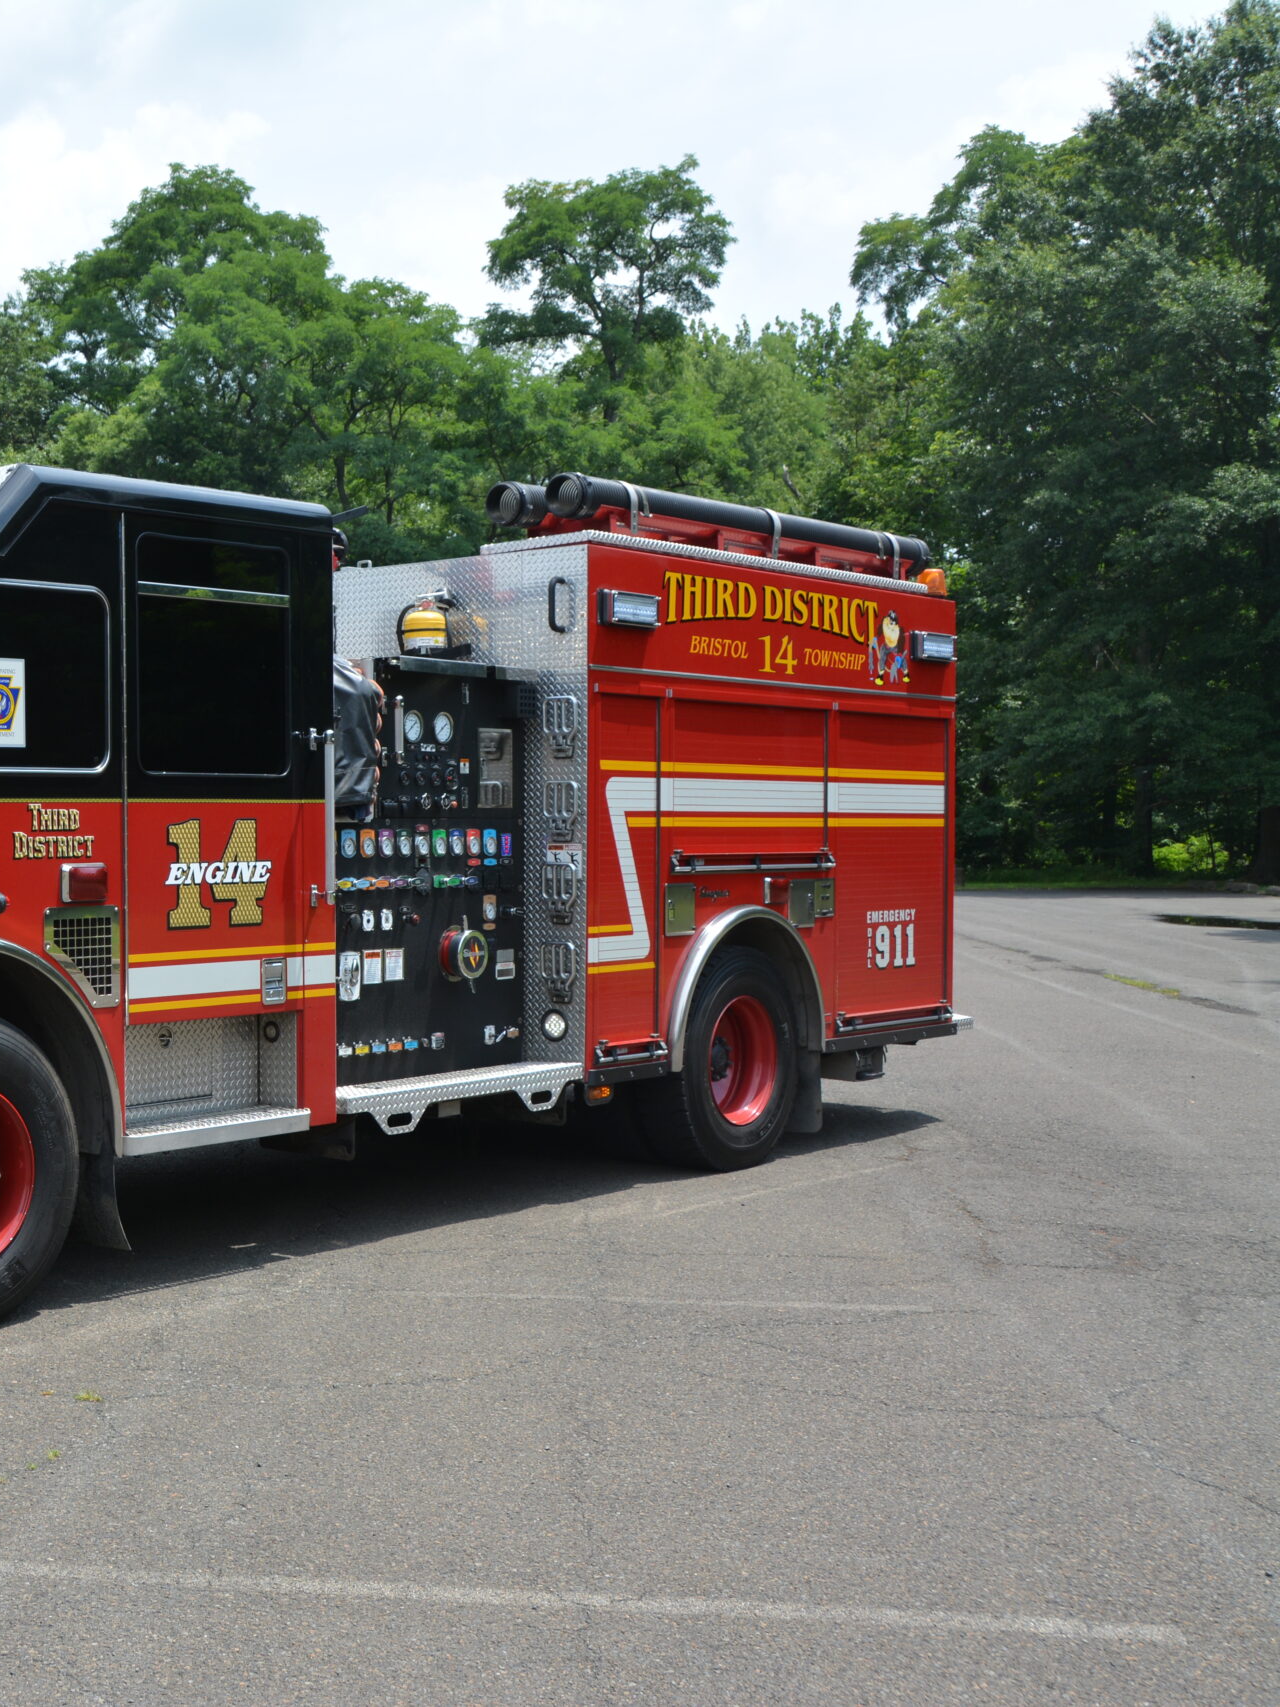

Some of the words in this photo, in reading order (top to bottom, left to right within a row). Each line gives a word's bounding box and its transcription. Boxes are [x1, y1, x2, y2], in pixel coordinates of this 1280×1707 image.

[663, 570, 757, 624] THIRD
[763, 585, 878, 646] DISTRICT
[689, 635, 749, 659] BRISTOL
[758, 634, 798, 675] 14
[803, 648, 866, 670] TOWNSHIP
[27, 803, 80, 831] THIRD
[13, 831, 95, 859] DISTRICT
[165, 861, 272, 885] ENGINE
[167, 818, 268, 930] 14
[867, 908, 916, 924] EMERGENCY
[875, 923, 916, 969] 911
